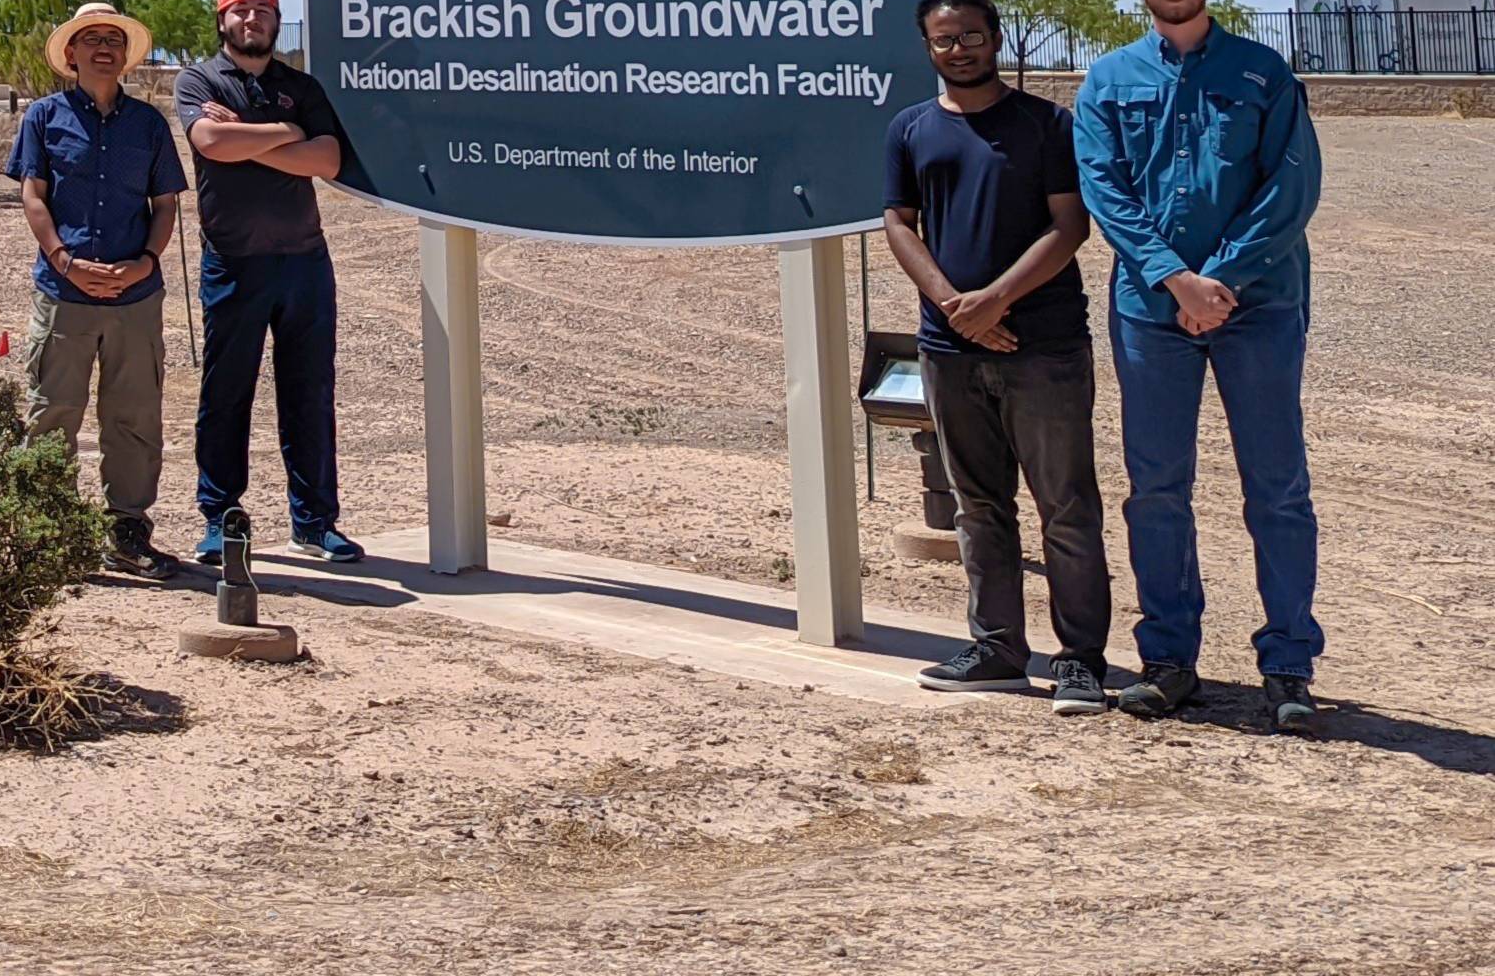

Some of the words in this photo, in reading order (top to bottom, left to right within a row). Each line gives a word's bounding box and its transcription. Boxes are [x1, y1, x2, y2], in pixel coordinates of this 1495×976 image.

[340, 60, 442, 91] National
[447, 61, 618, 94] Desalination
[624, 62, 770, 96] Research
[776, 63, 893, 107] Facility
[448, 141, 488, 165] U.S.
[494, 143, 611, 170] Department
[617, 147, 637, 170] of
[642, 148, 676, 171] the
[683, 149, 759, 174] Interior
